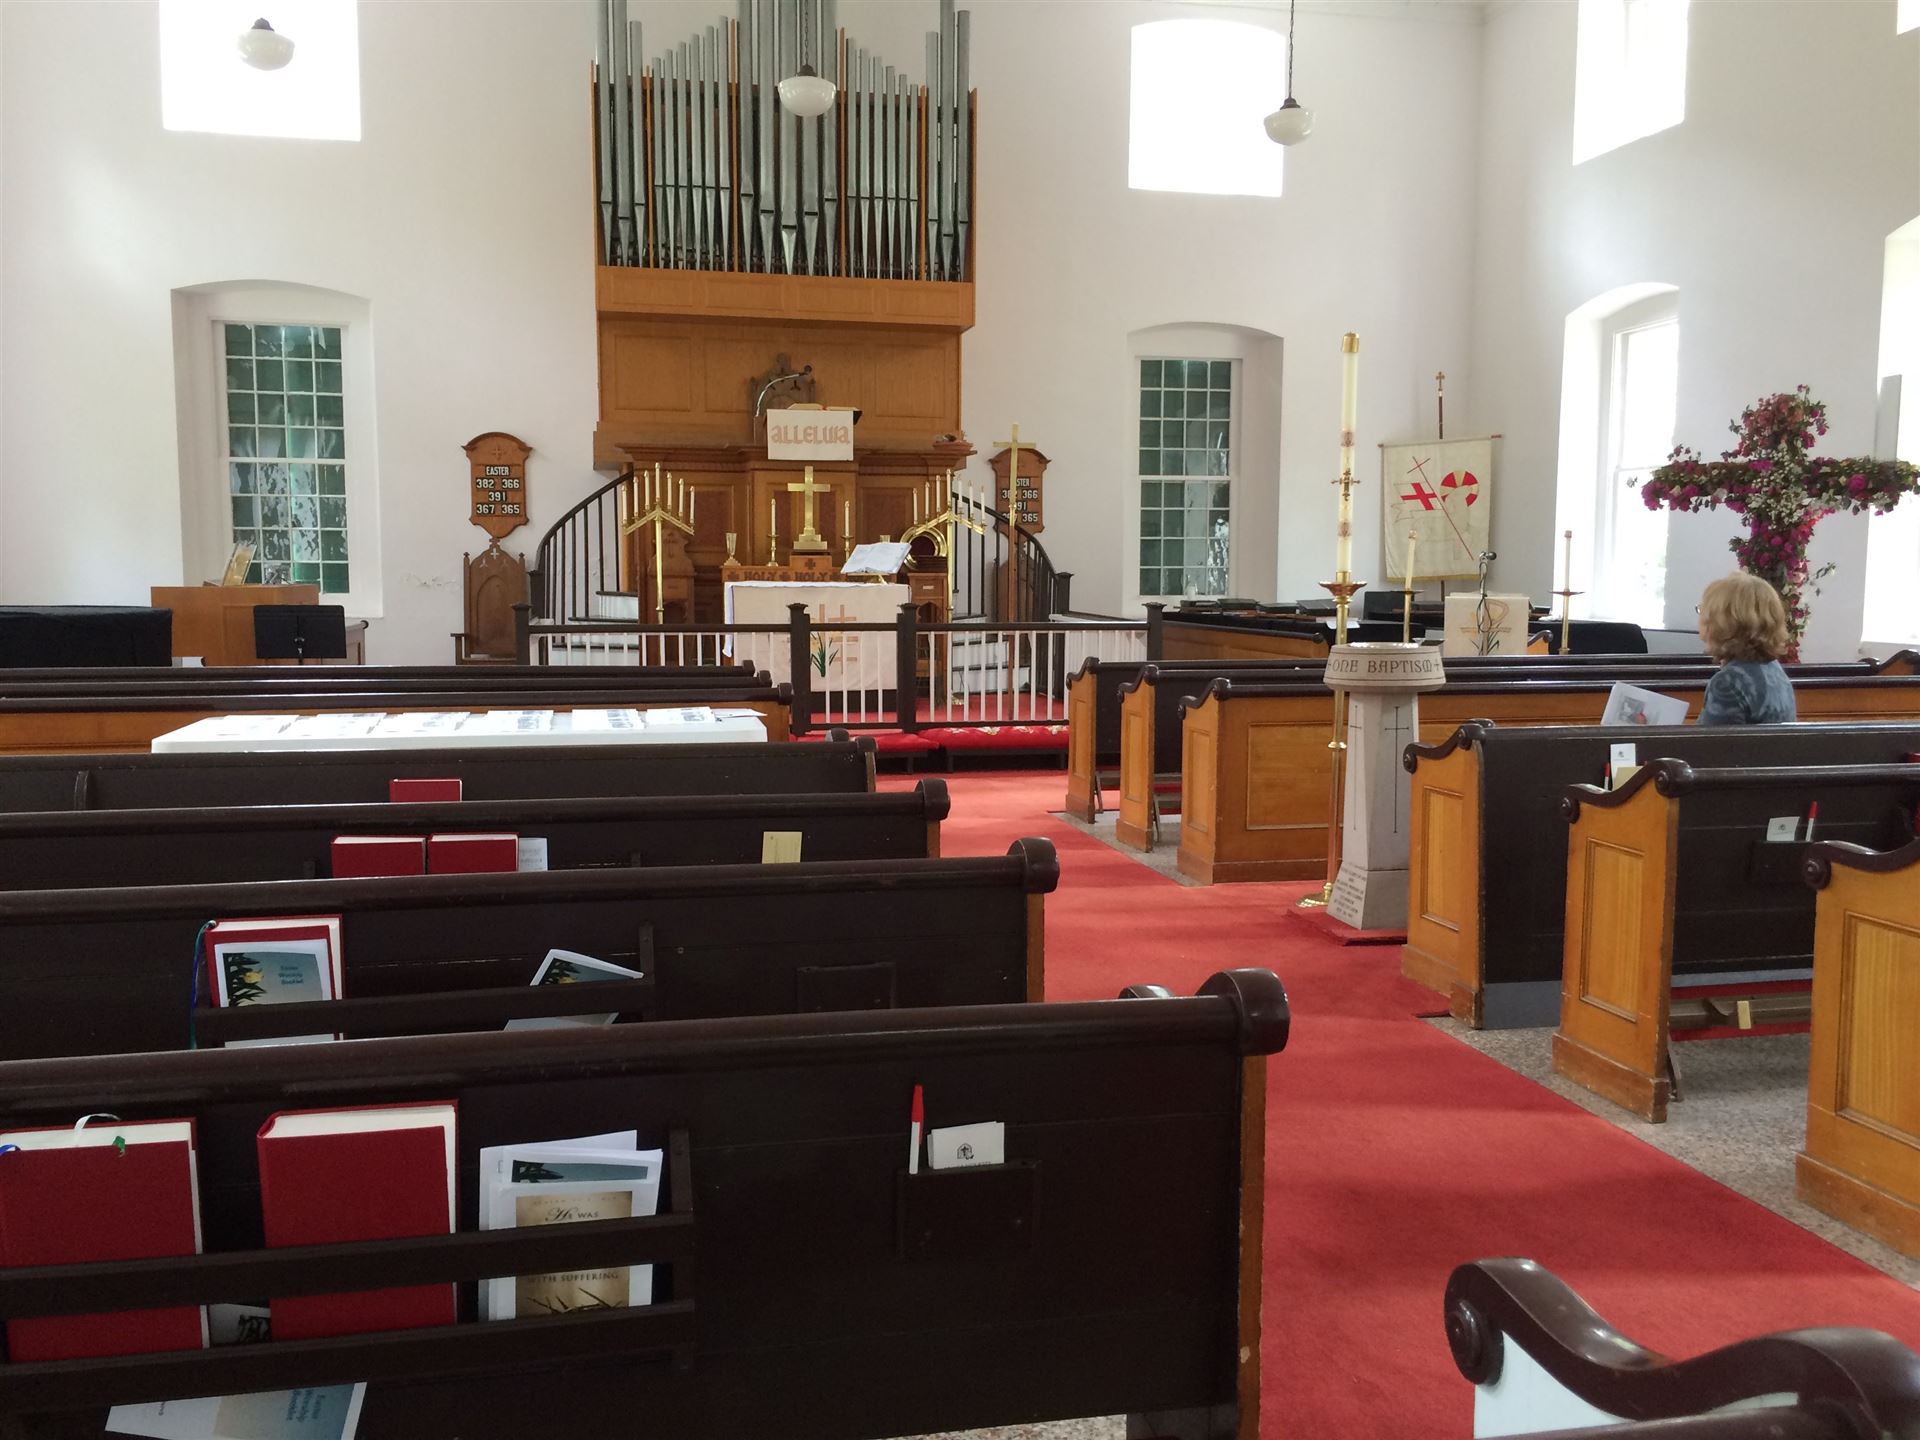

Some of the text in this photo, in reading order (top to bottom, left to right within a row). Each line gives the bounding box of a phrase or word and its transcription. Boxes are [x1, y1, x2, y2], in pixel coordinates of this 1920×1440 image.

[486, 466, 509, 475] EASTER
[476, 479, 520, 488] 382 366
[488, 491, 506, 501] 391
[1022, 489, 1038, 499] 366
[476, 504, 520, 514] 367 365
[1022, 513, 1038, 522] 365
[744, 571, 828, 581] HOLY HOLY
[1332, 660, 1433, 674] ONE BAPTISM
[578, 1211, 600, 1219] WAS
[561, 1272, 619, 1282] SUFFERING
